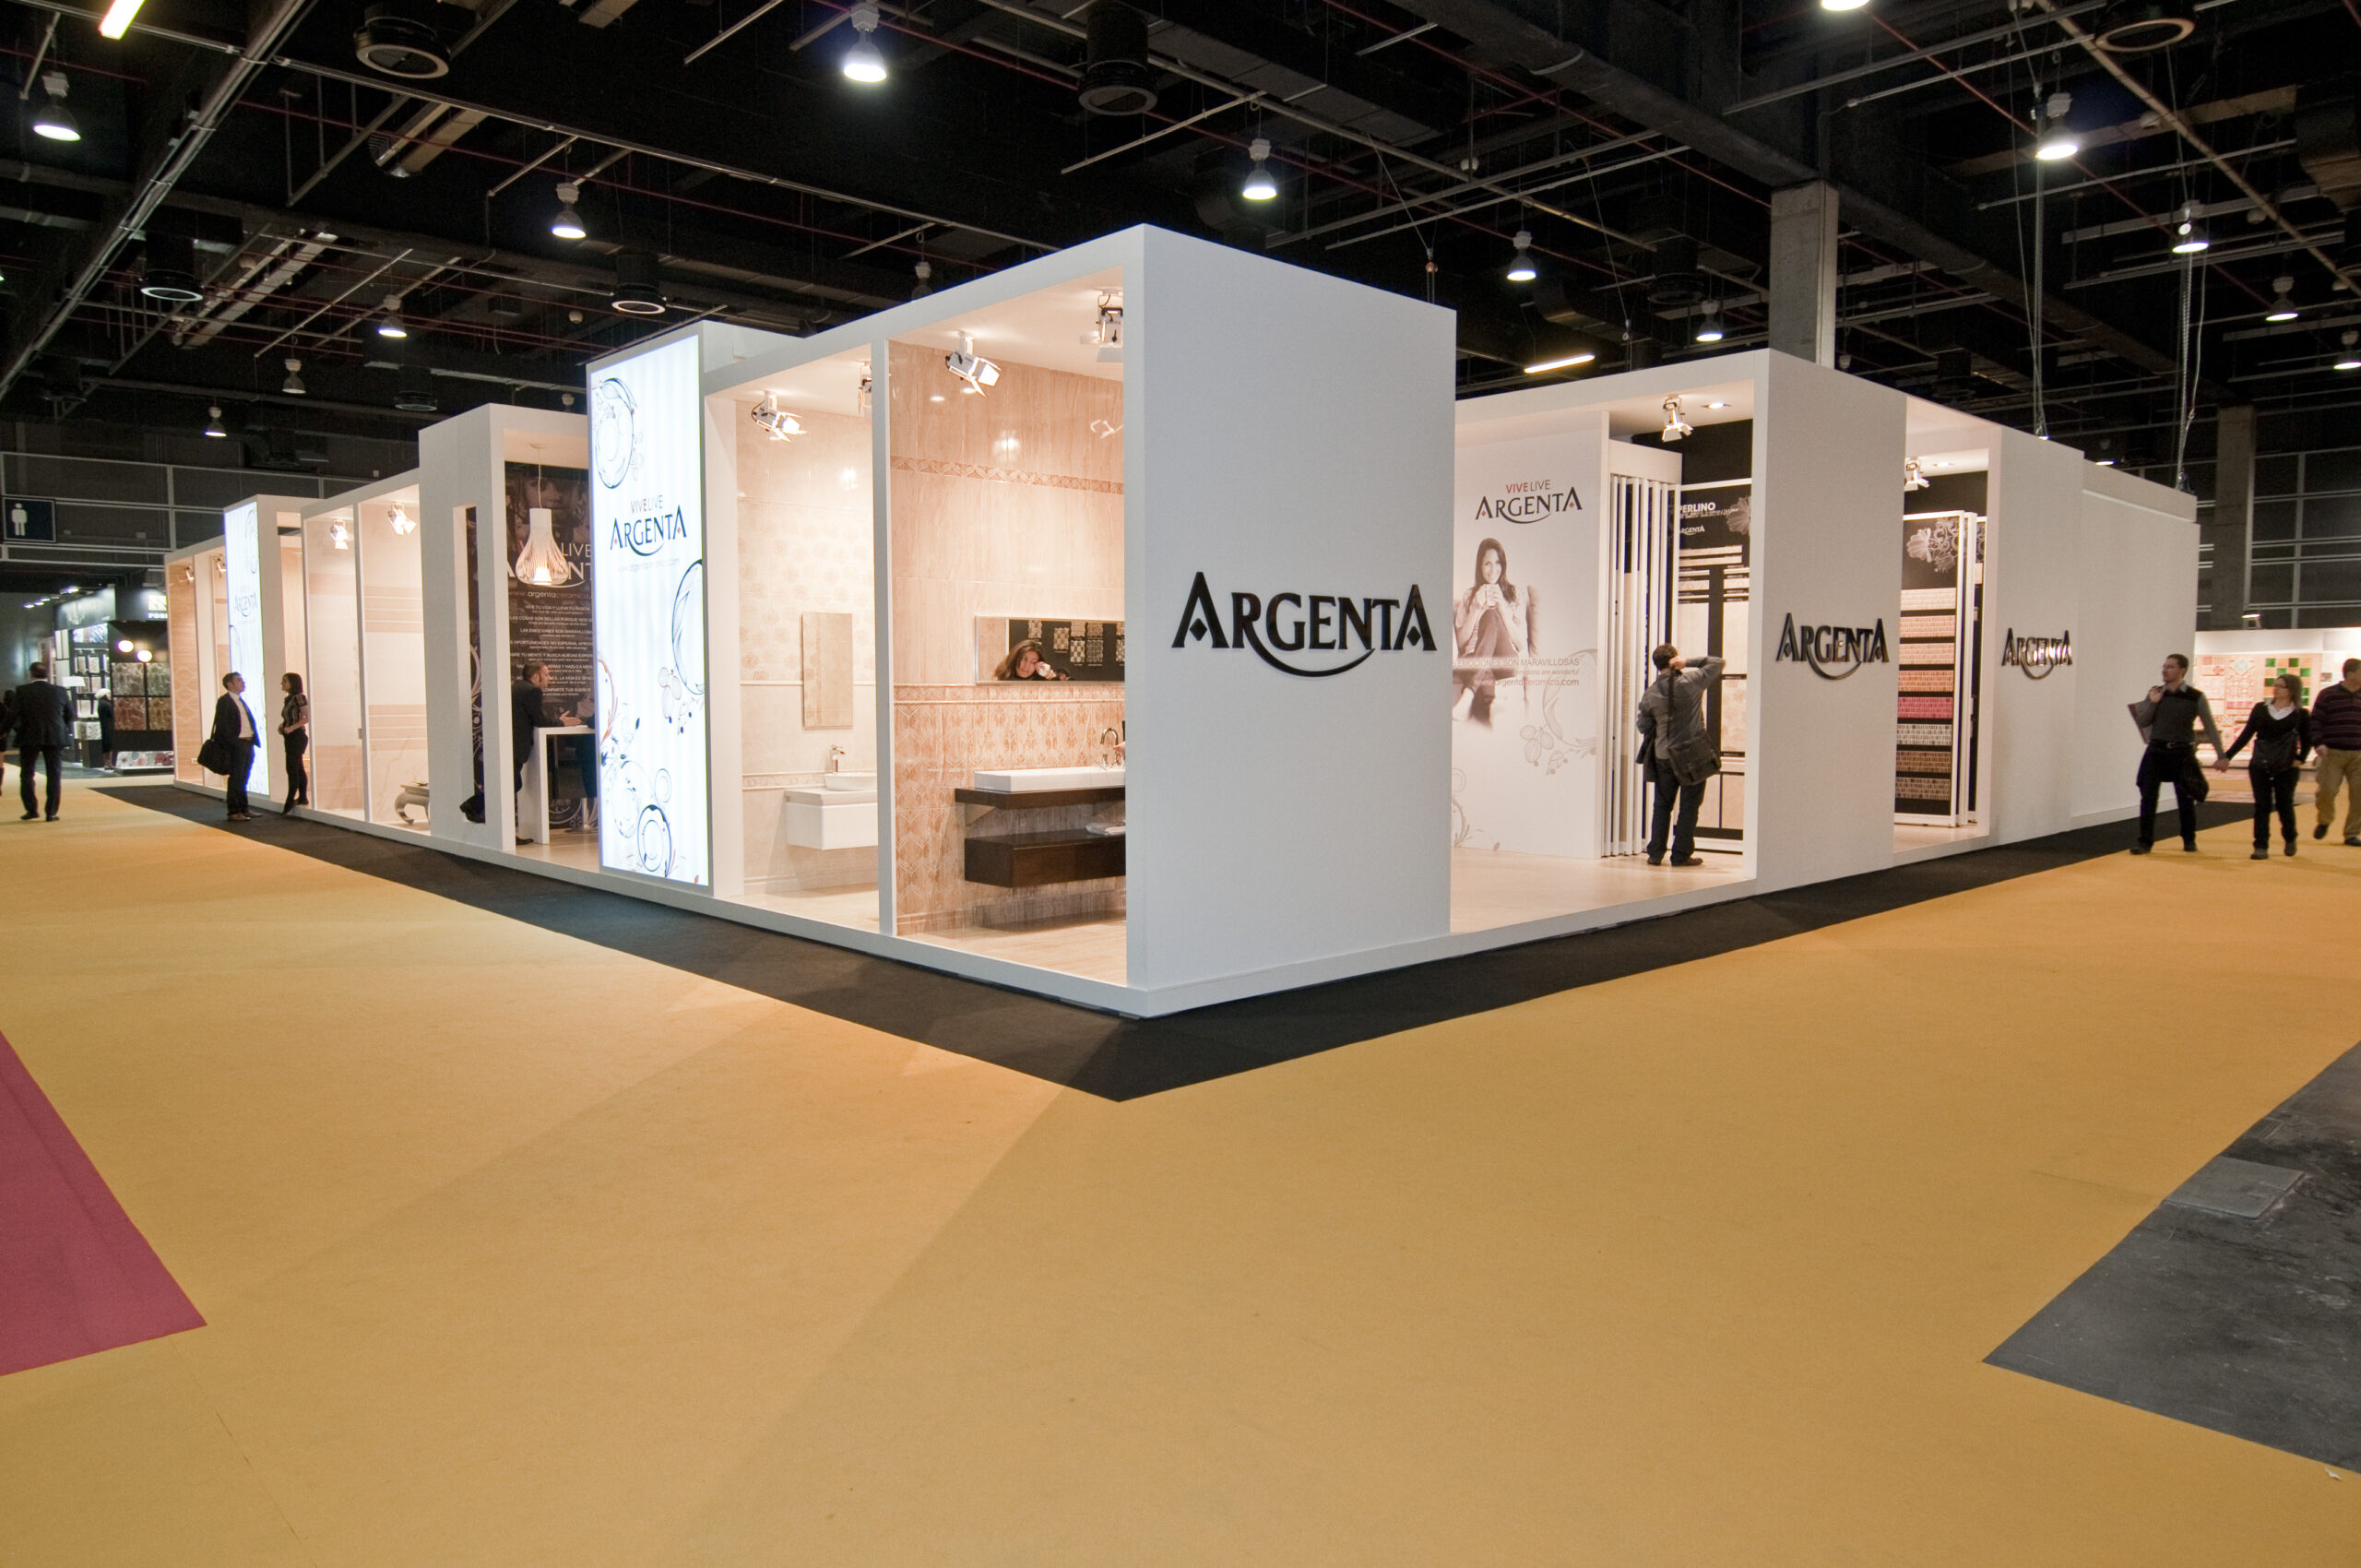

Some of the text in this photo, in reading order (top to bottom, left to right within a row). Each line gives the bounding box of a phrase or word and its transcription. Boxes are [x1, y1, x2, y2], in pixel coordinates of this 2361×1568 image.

[610, 504, 687, 556] ARGENTA
[1476, 487, 1583, 524] ARGENTA
[1679, 525, 1705, 535] RGENTA
[1171, 571, 1437, 677] ARGENTA
[1775, 612, 1890, 680] ARGENTA
[2001, 627, 2072, 680] ARGENTA
